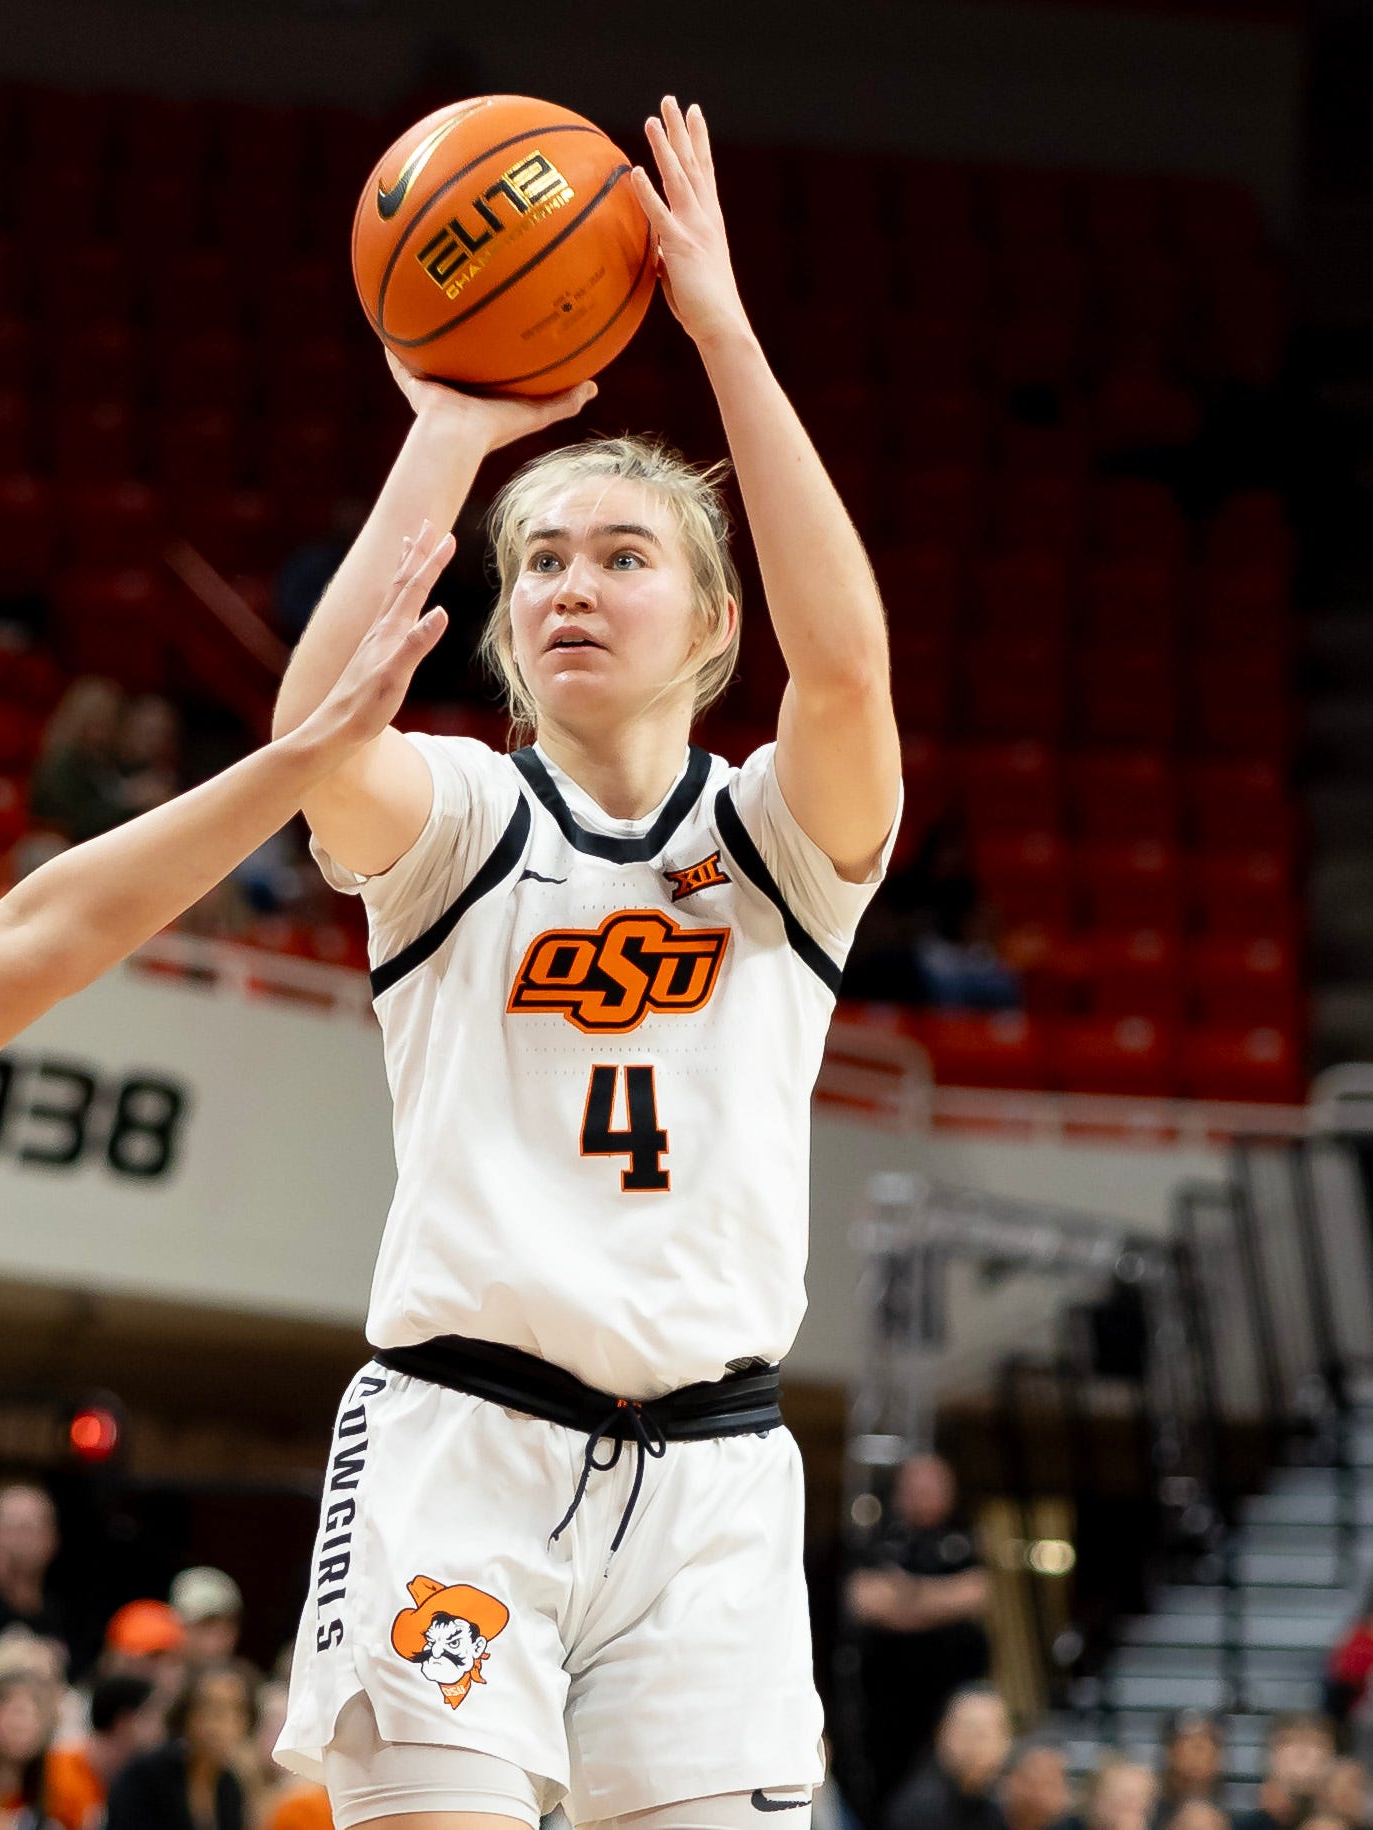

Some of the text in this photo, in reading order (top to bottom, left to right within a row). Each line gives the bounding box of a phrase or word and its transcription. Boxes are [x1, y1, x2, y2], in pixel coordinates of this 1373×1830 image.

[415, 150, 569, 290] ELITE
[673, 853, 723, 897] XII
[506, 909, 731, 1034] OSU
[580, 1064, 670, 1192] 4
